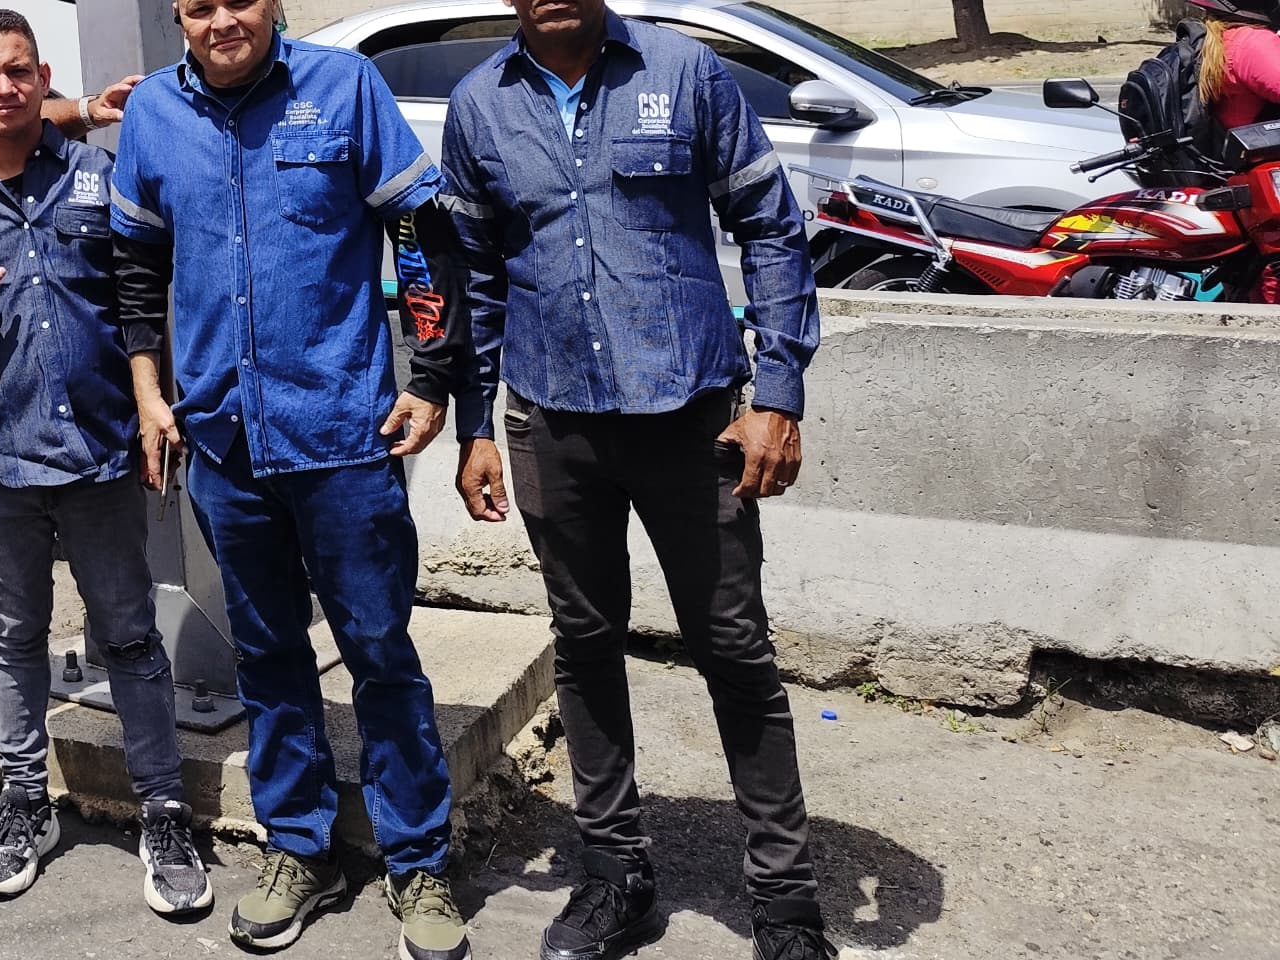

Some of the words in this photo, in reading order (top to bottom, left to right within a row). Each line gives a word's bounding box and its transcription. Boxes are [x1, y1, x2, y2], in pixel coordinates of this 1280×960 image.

[293, 101, 313, 109] CSC
[637, 92, 671, 118] CSC
[74, 169, 99, 193] CSC
[872, 194, 910, 212] KADI
[1135, 190, 1199, 206] KADI
